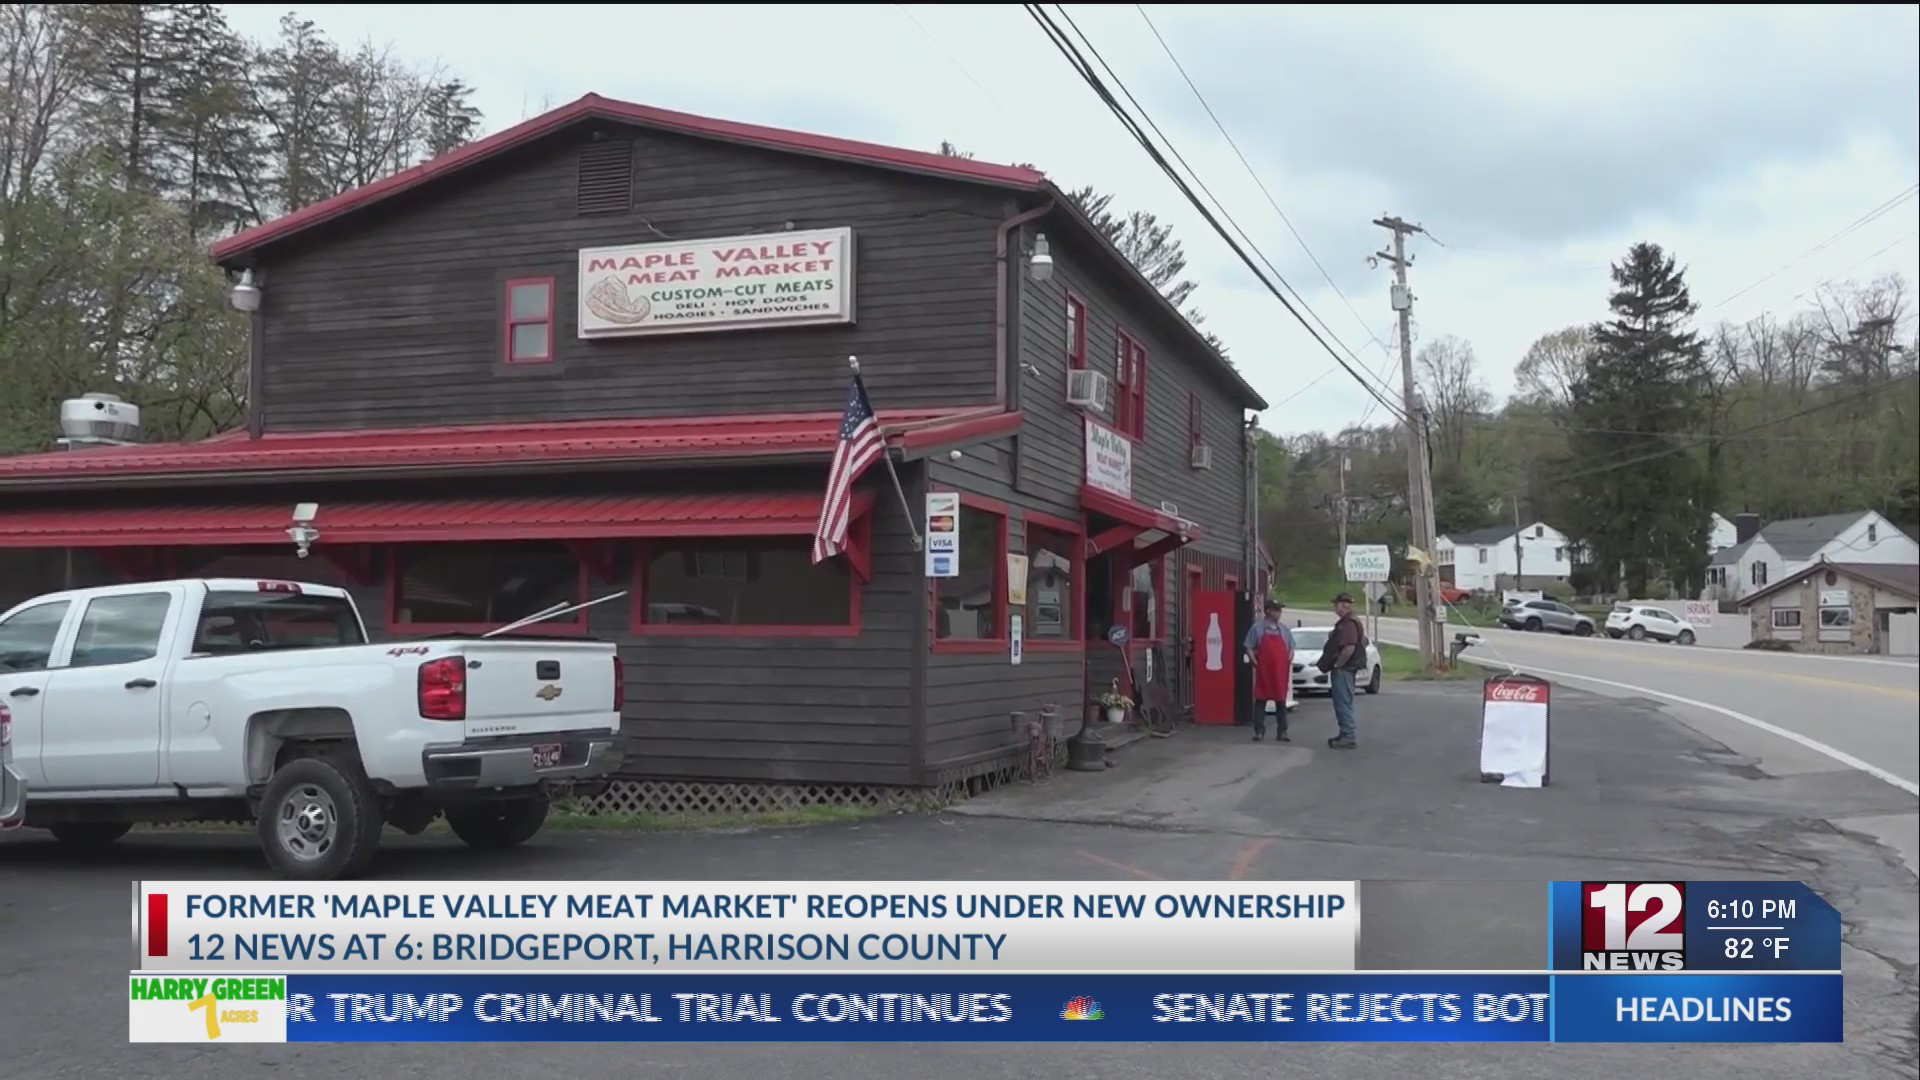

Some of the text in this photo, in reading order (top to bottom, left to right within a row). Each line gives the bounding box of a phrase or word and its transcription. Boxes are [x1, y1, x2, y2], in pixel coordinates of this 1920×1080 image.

[588, 241, 833, 272] MAPLE VALLEY
[628, 260, 834, 285] MEAT MARKET
[651, 279, 834, 302] CUSTOM-CUT MEATS
[654, 303, 829, 320] HOAGIES SANDWICHES
[676, 295, 807, 310] DELI HOT DOGS
[933, 539, 953, 547] VISA
